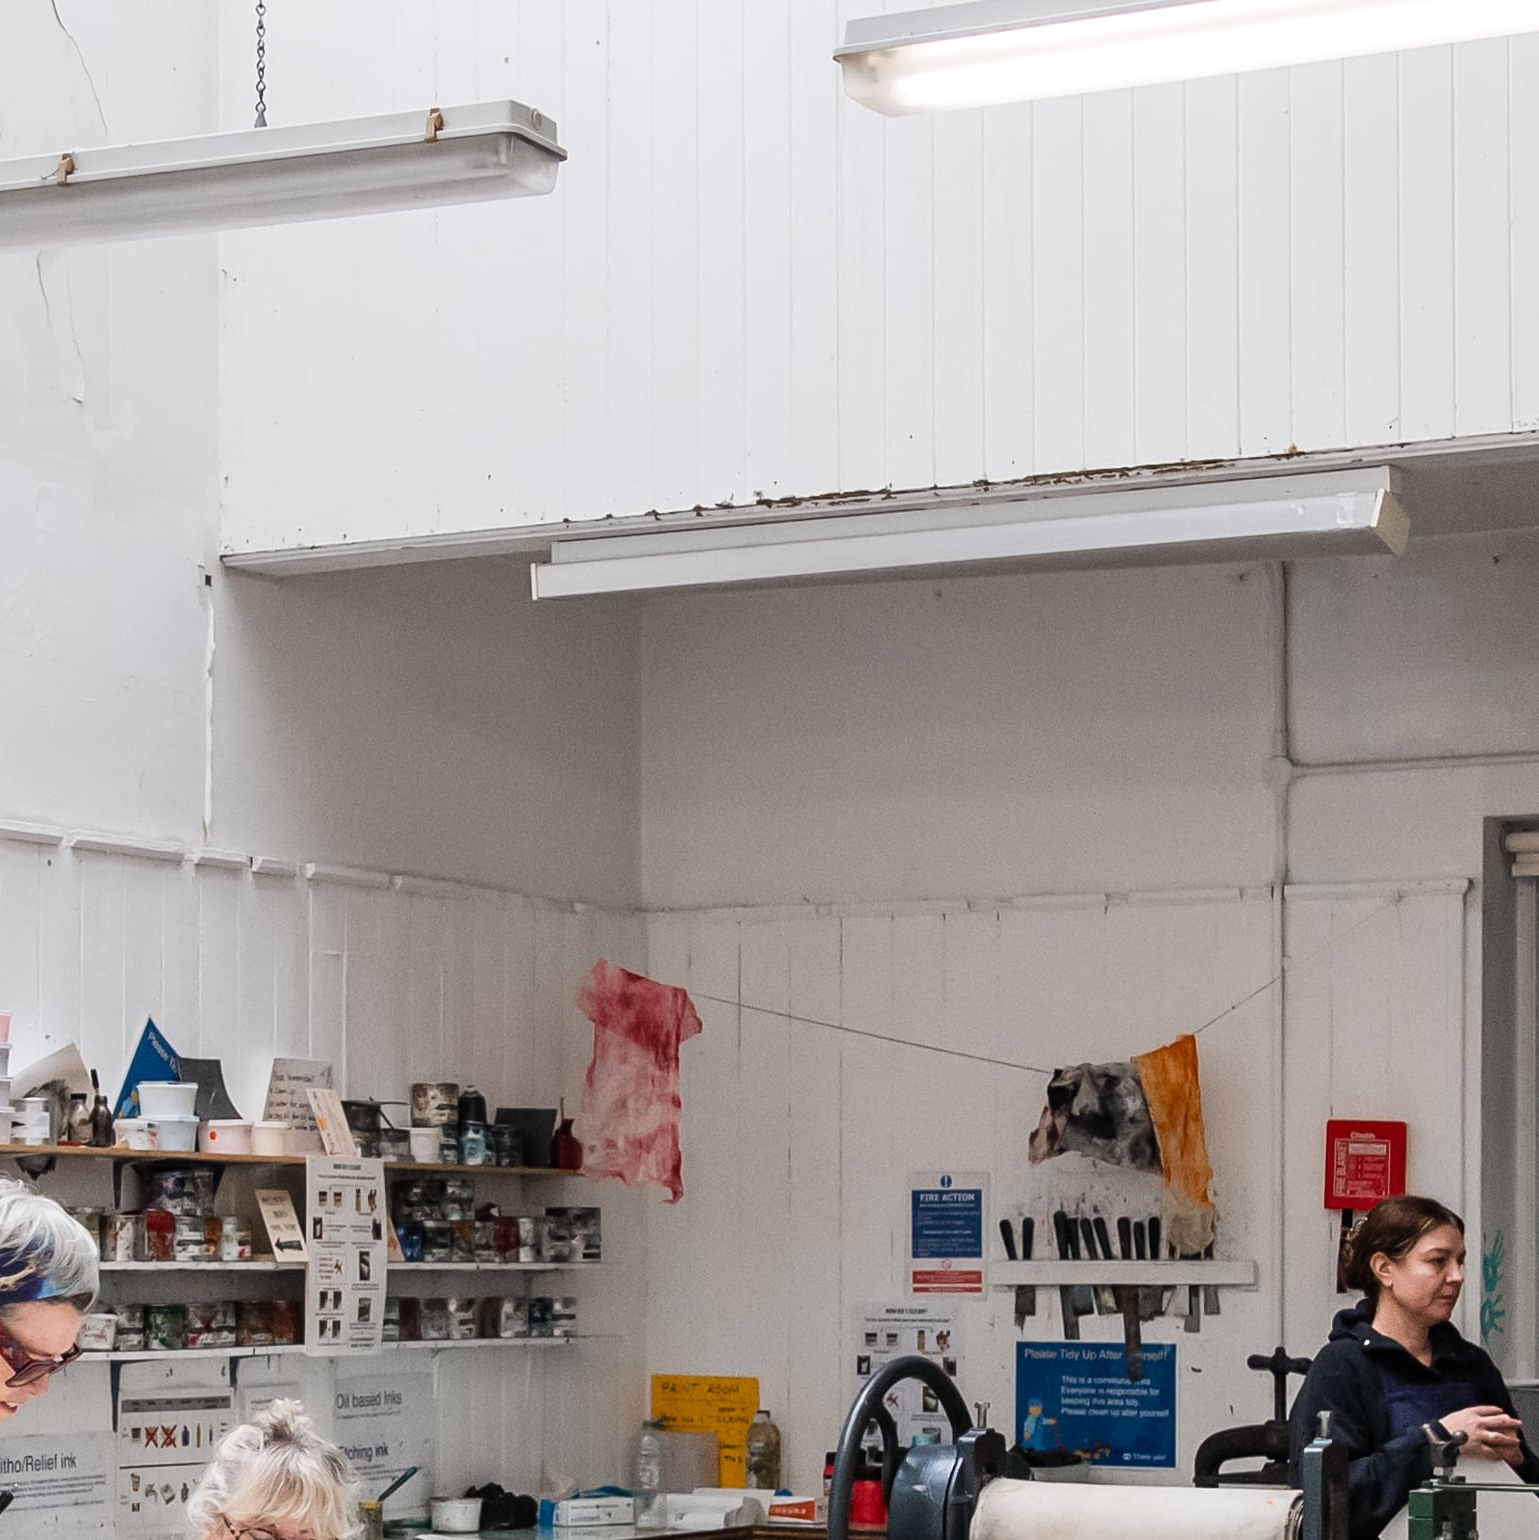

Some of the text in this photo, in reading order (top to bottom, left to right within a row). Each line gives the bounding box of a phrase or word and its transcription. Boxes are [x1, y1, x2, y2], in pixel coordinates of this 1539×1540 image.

[920, 1193, 975, 1201] FIRE ACTION
[1024, 1347, 1057, 1359] Please
[1060, 1349, 1080, 1361] Tidy
[1082, 1349, 1097, 1361] Up
[1099, 1349, 1123, 1360] After
[1062, 1376, 1078, 1384] This
[1093, 1377, 1132, 1385] communa
[1061, 1386, 1096, 1396] Everyone
[1106, 1387, 1148, 1397] responsible
[337, 1390, 403, 1409] Oil based Inks
[1061, 1397, 1090, 1407] keeping
[1061, 1407, 1087, 1416] Please
[1088, 1408, 1109, 1416] clean
[1110, 1409, 1120, 1417] up
[375, 1442, 389, 1457] ink
[60, 1452, 77, 1469] ink
